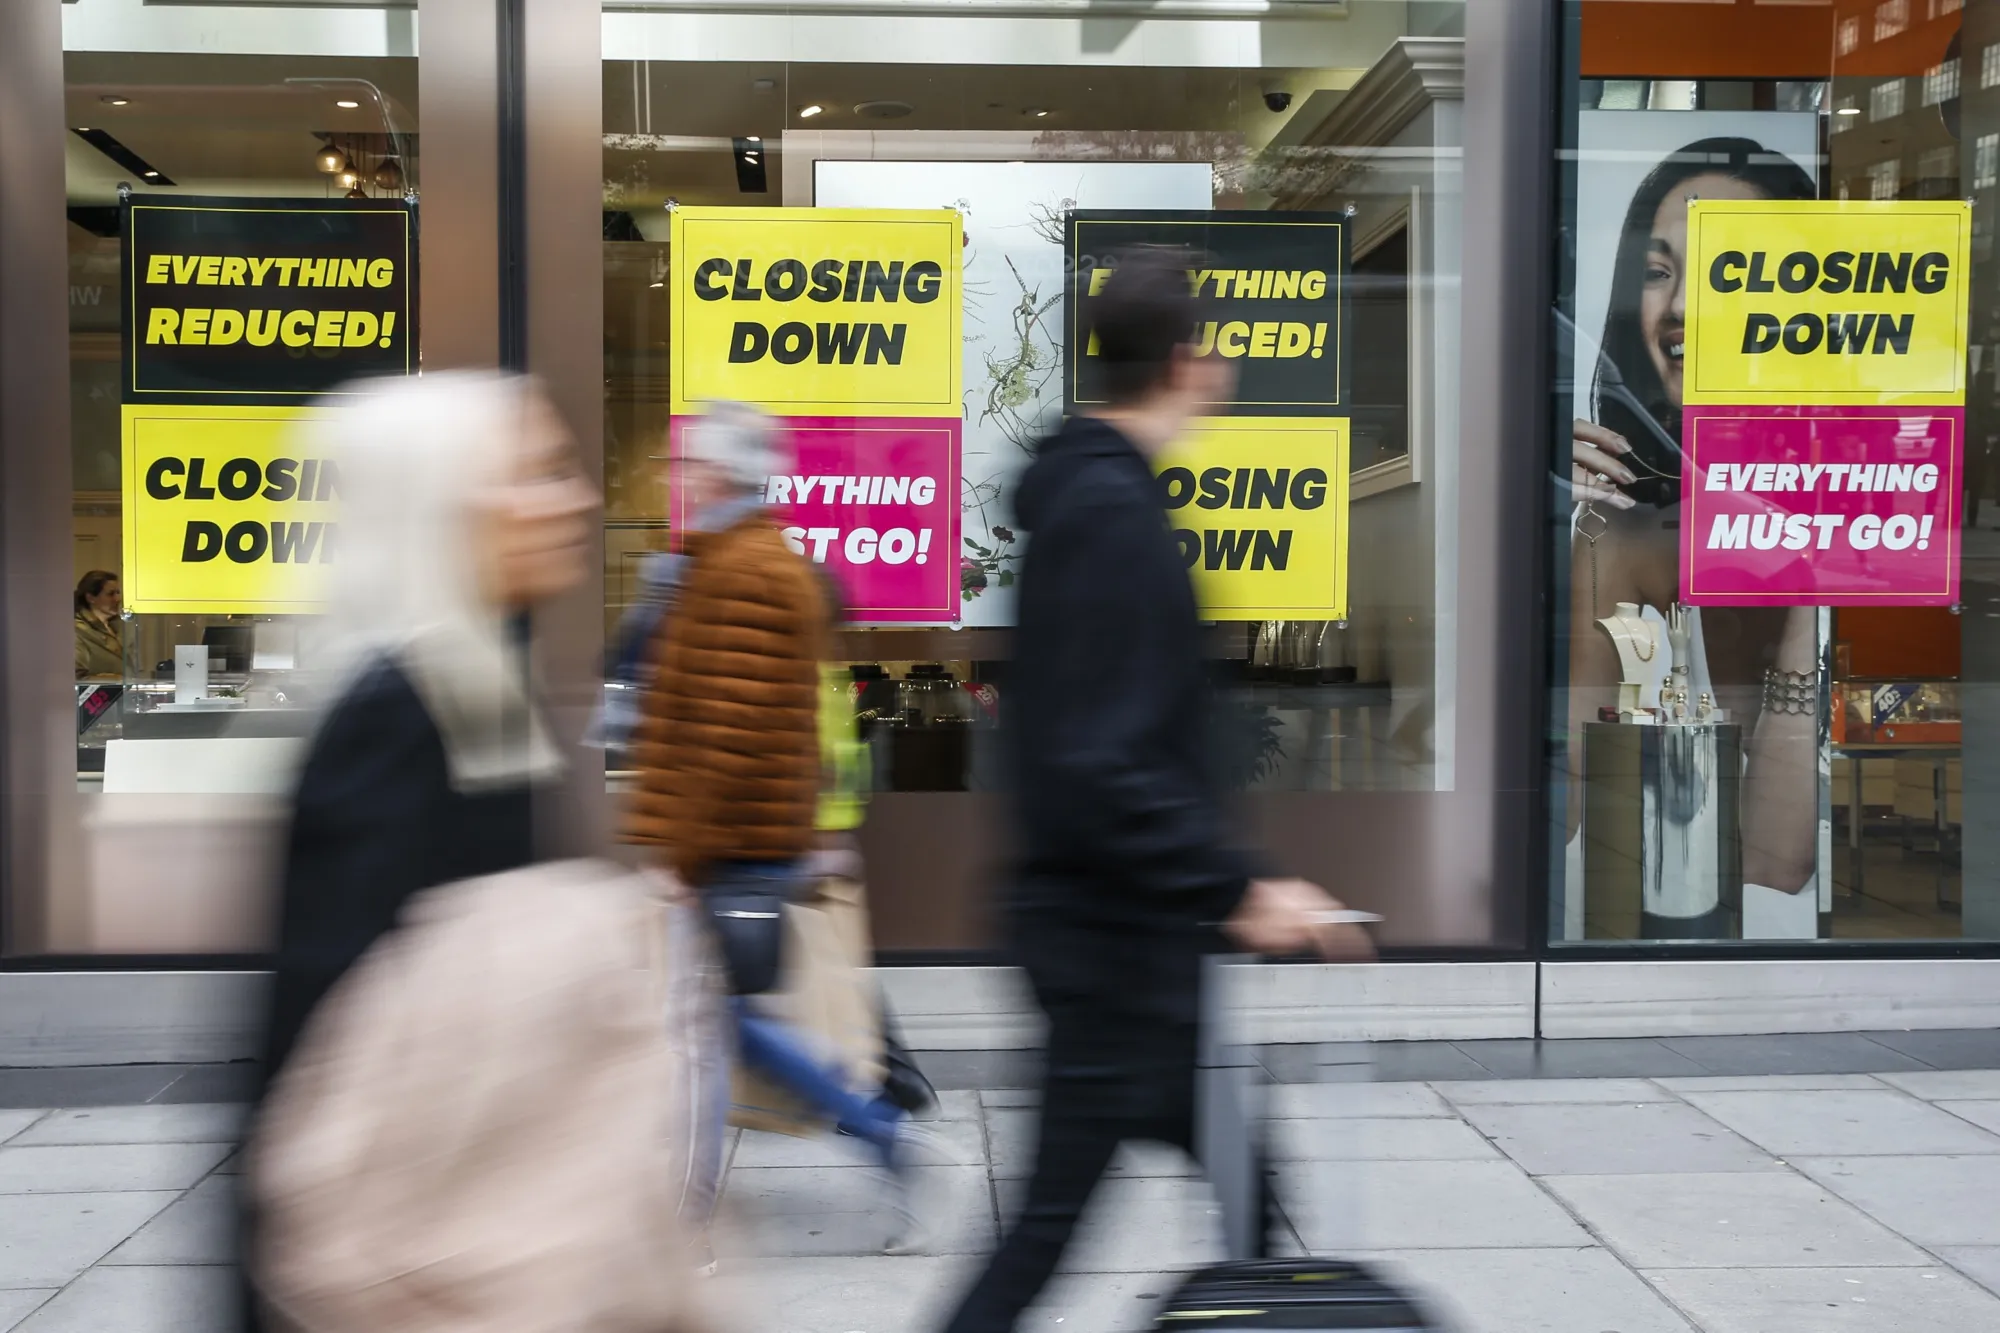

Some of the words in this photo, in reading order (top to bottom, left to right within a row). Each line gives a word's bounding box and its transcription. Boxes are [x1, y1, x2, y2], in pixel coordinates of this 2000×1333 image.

[146, 254, 395, 289] EVERYTHING
[693, 257, 942, 304] CLOSING
[1088, 268, 1327, 300] EYTHING
[1709, 250, 1950, 295] CLOSING
[145, 307, 396, 349] REDUCED!
[728, 321, 907, 366] DOWN
[1087, 321, 1328, 359] UCED!
[1741, 312, 1915, 355] DOWN
[145, 456, 344, 502] CLOSIN
[757, 475, 936, 506] RYTHING
[1155, 466, 1328, 511] OSING
[1704, 463, 1939, 493] EVERYTHING
[780, 526, 840, 564] ST
[844, 527, 933, 565] GO!
[1171, 528, 1294, 571] OWN
[1706, 513, 1845, 551] MUST
[1848, 513, 1935, 551] GO!
